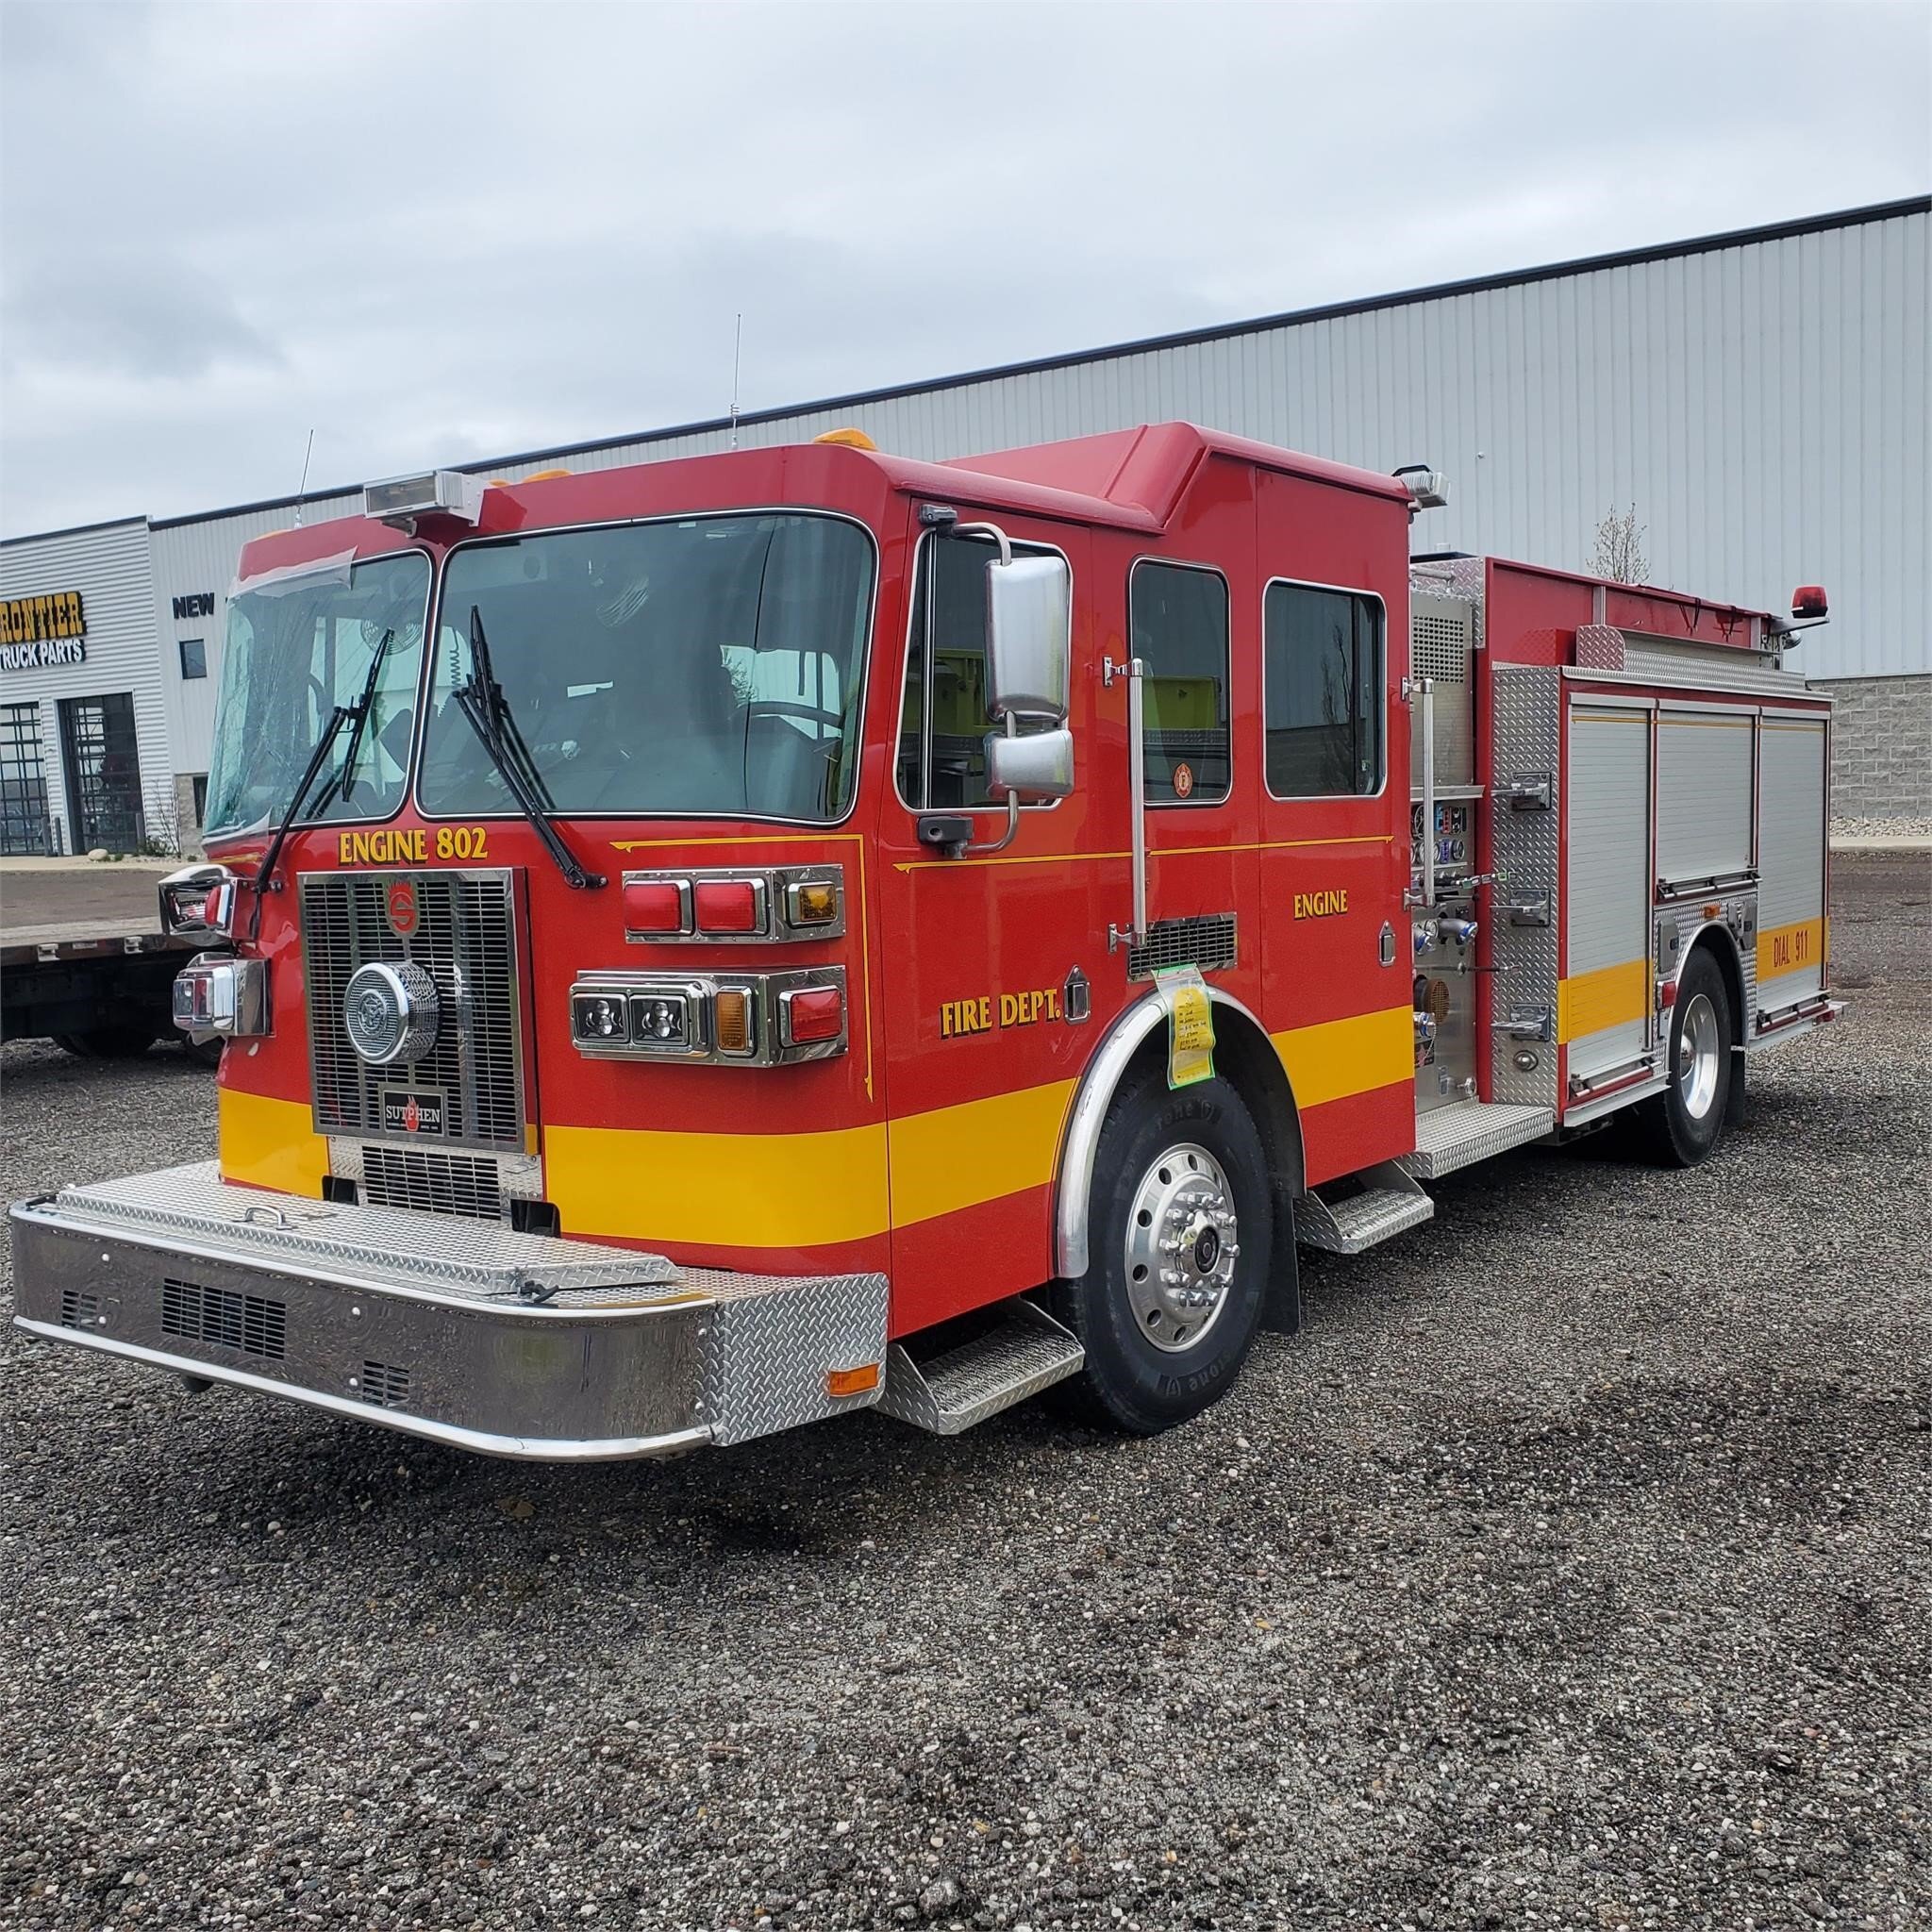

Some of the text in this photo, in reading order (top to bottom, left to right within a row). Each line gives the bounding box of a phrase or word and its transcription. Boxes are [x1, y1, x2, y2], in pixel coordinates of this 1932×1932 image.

[172, 592, 214, 619] NEW
[40, 639, 83, 665] PARTS
[340, 826, 489, 863] ENGINE 802
[1293, 890, 1348, 920] ENGINE
[1774, 929, 1807, 967] DIAL 911
[941, 989, 1061, 1039] FIRE DEPT.
[386, 1105, 441, 1123] SUTPHEN
